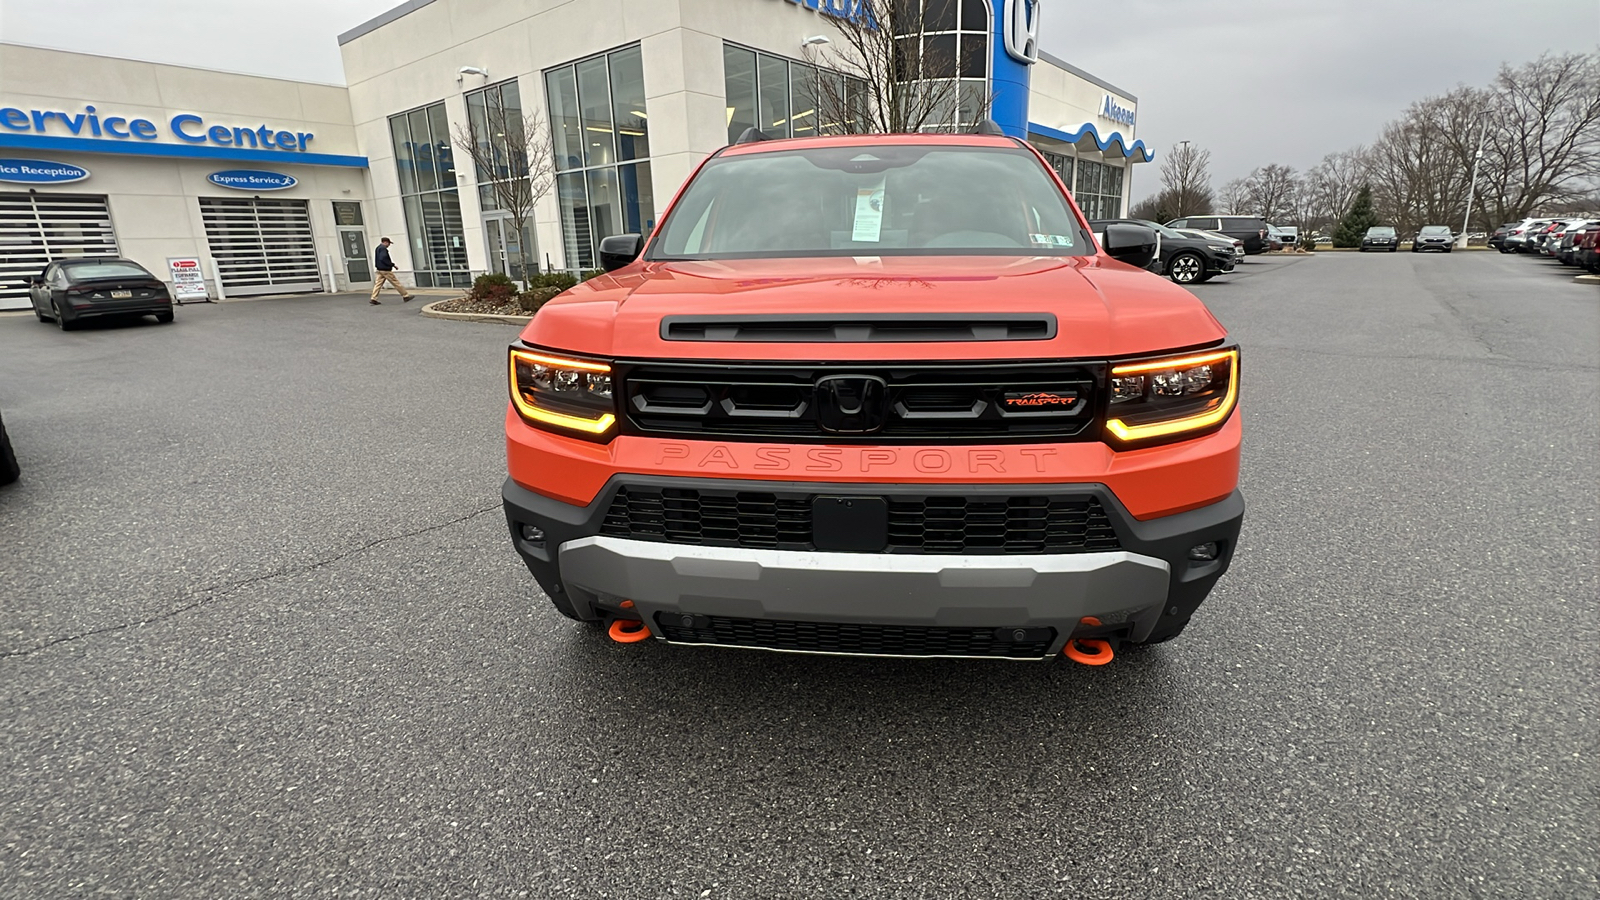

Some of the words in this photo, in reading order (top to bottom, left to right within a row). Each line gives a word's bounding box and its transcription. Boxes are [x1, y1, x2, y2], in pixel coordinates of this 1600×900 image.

[170, 114, 314, 150] Center
[21, 165, 81, 177] Reception
[213, 174, 248, 184] Express
[248, 175, 281, 184] Service
[1006, 397, 1076, 406] TRAILSPORT
[655, 443, 1057, 473] PASSPORT
